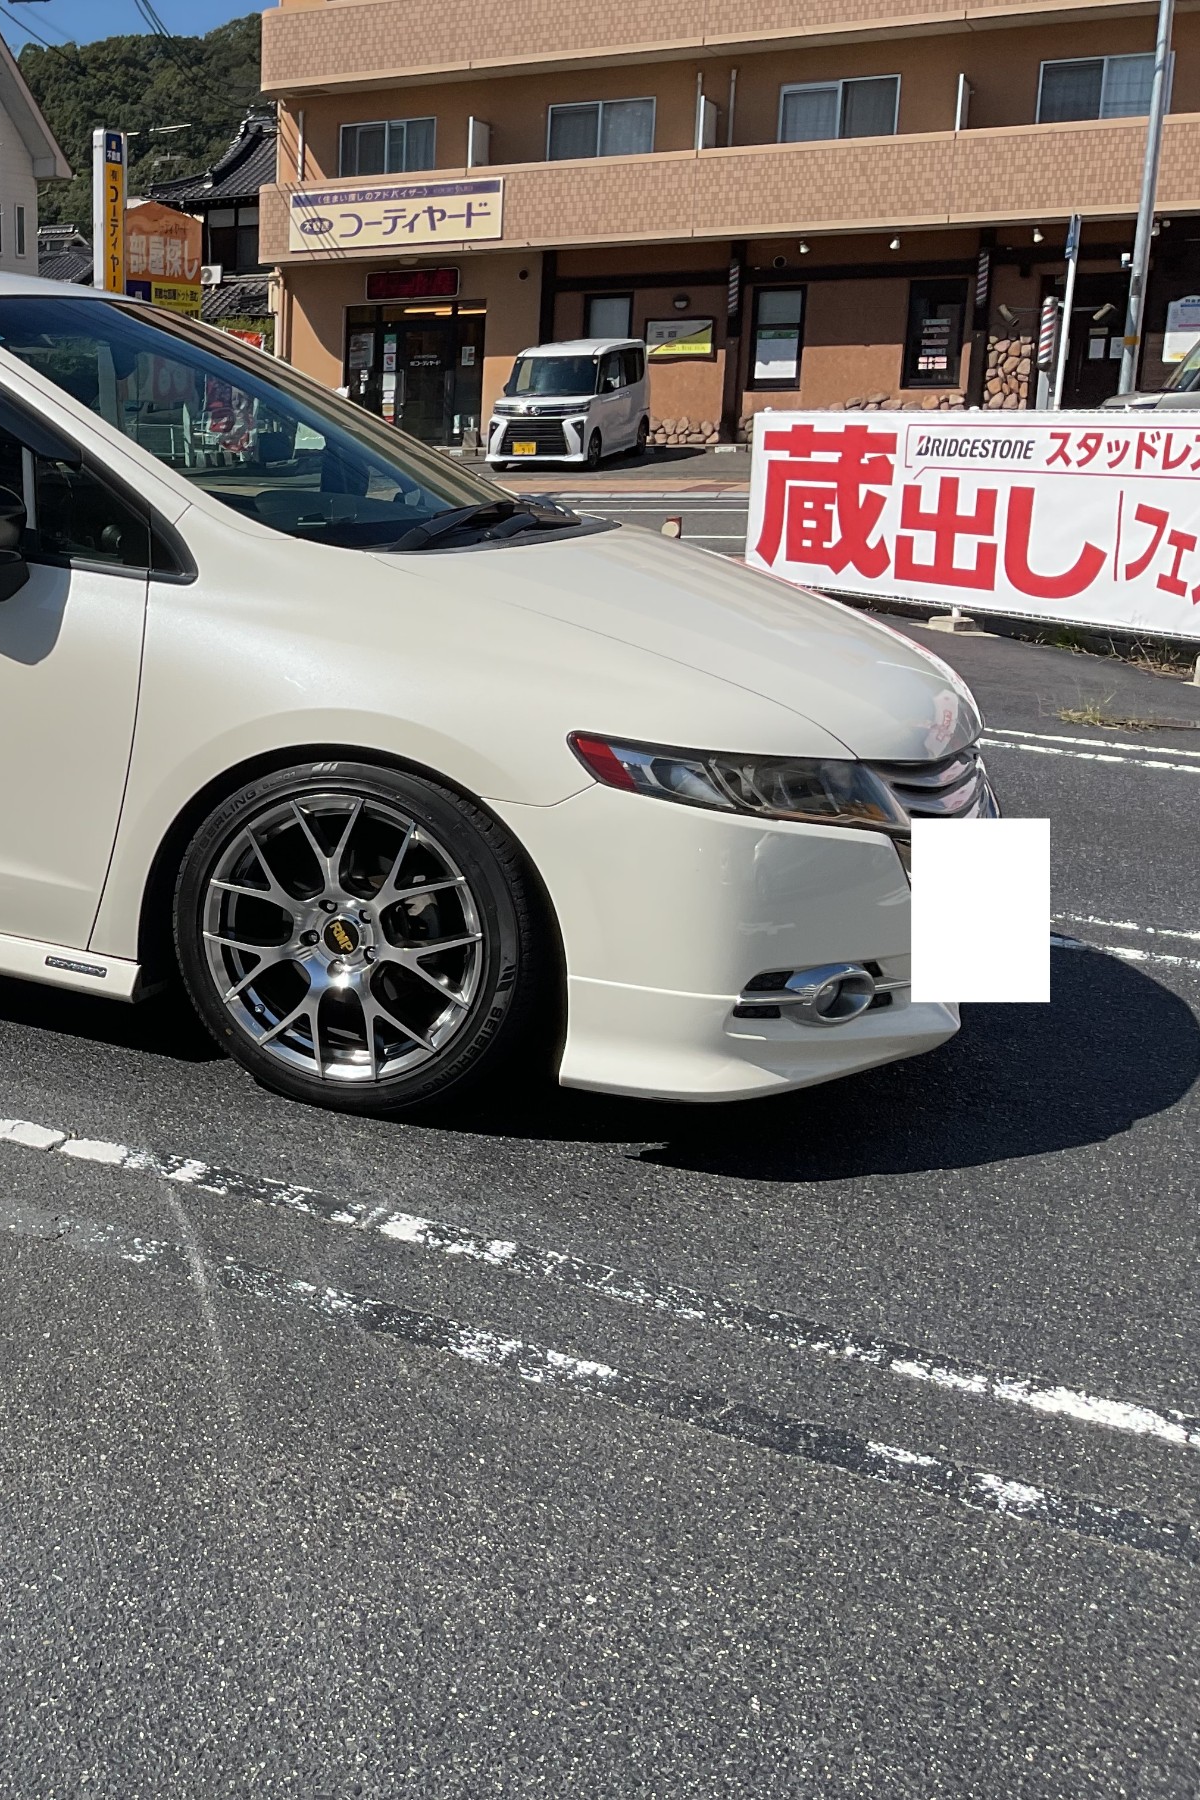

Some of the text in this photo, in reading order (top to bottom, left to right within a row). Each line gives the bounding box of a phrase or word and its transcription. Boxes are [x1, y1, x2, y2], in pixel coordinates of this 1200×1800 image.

[339, 202, 491, 238] コーティヤード
[129, 232, 198, 280] 部屋探し
[915, 435, 1036, 461] BRIDGESTONE
[755, 424, 1108, 599] 蔵出し
[1125, 503, 1200, 605] フェ
